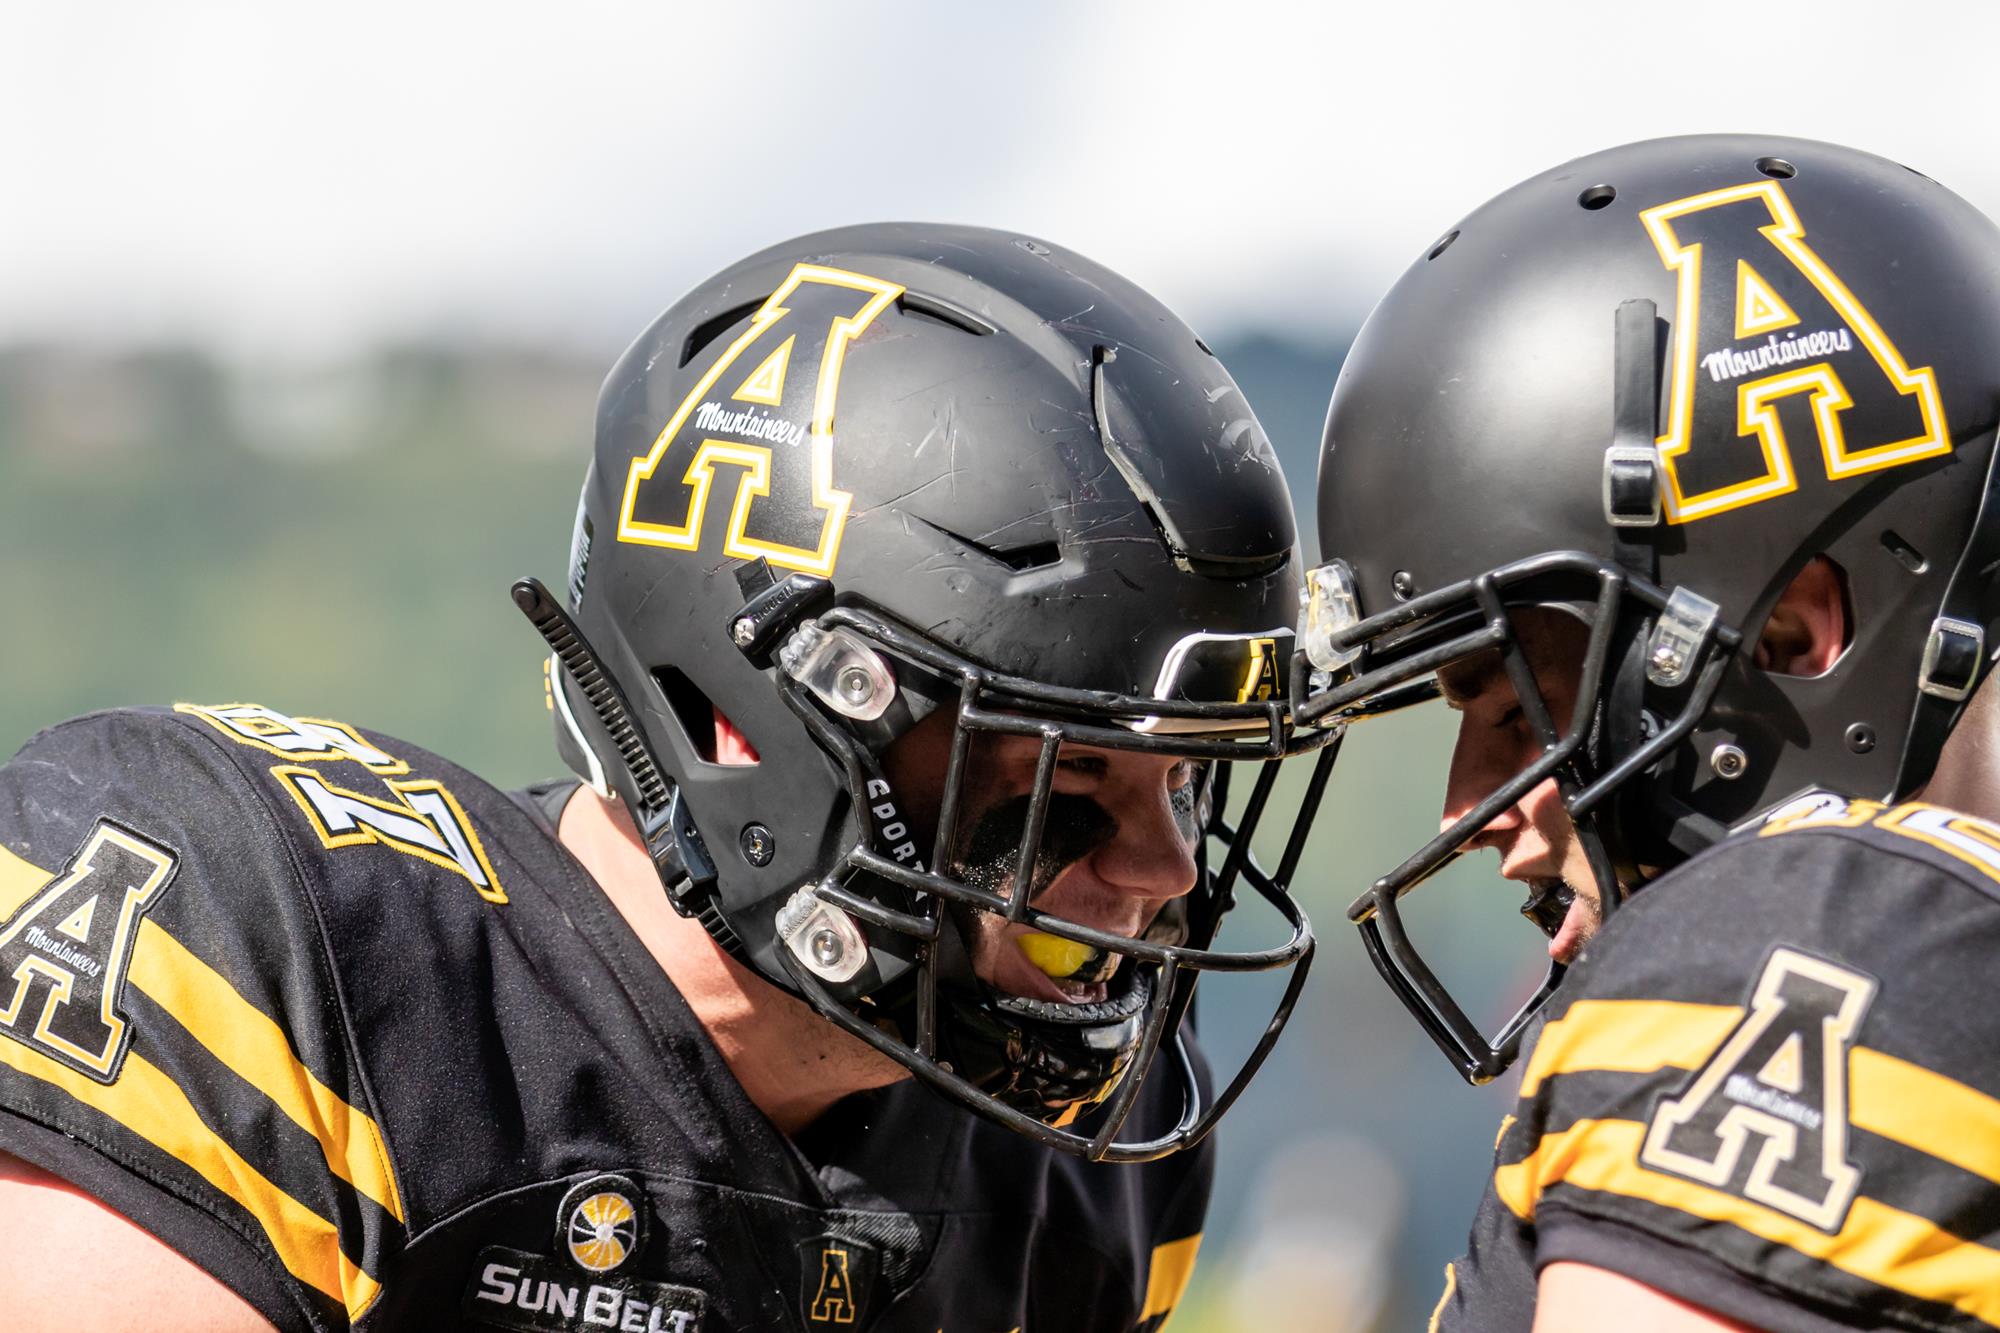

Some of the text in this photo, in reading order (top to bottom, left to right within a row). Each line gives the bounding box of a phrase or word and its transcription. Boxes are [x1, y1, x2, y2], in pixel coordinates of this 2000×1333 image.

[1639, 180, 1953, 526] A
[1701, 327, 1852, 382] Mountaineers
[617, 262, 906, 577] A
[696, 401, 804, 448] Mountaineers
[866, 778, 928, 902] SPORT
[0, 824, 175, 1076] A
[25, 925, 101, 979] Mountaineers
[1640, 946, 1881, 1232] A
[811, 1249, 856, 1323] A
